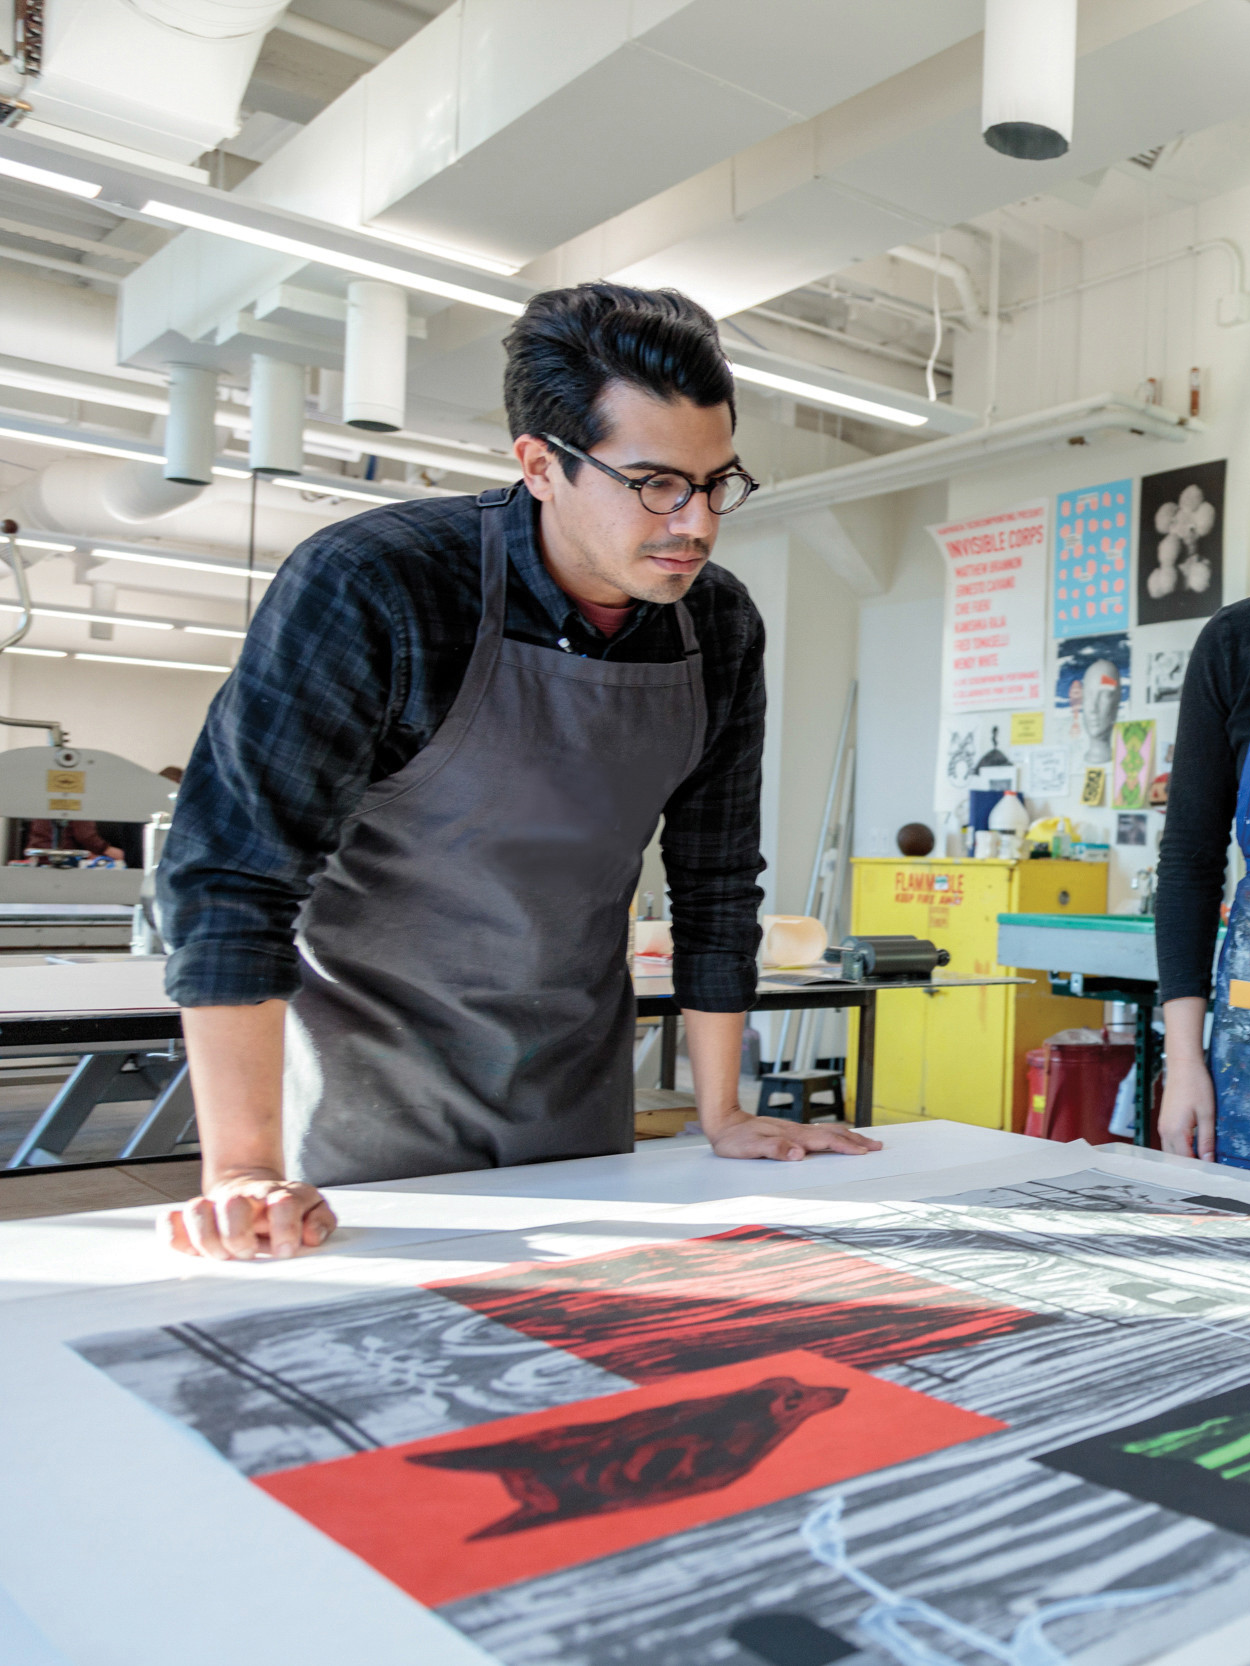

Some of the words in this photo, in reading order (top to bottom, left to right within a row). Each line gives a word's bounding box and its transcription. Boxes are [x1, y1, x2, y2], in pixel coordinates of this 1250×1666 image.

[945, 531, 1005, 559] INVISIBLE
[1008, 524, 1044, 549] CORPS
[917, 894, 934, 904] FIRE
